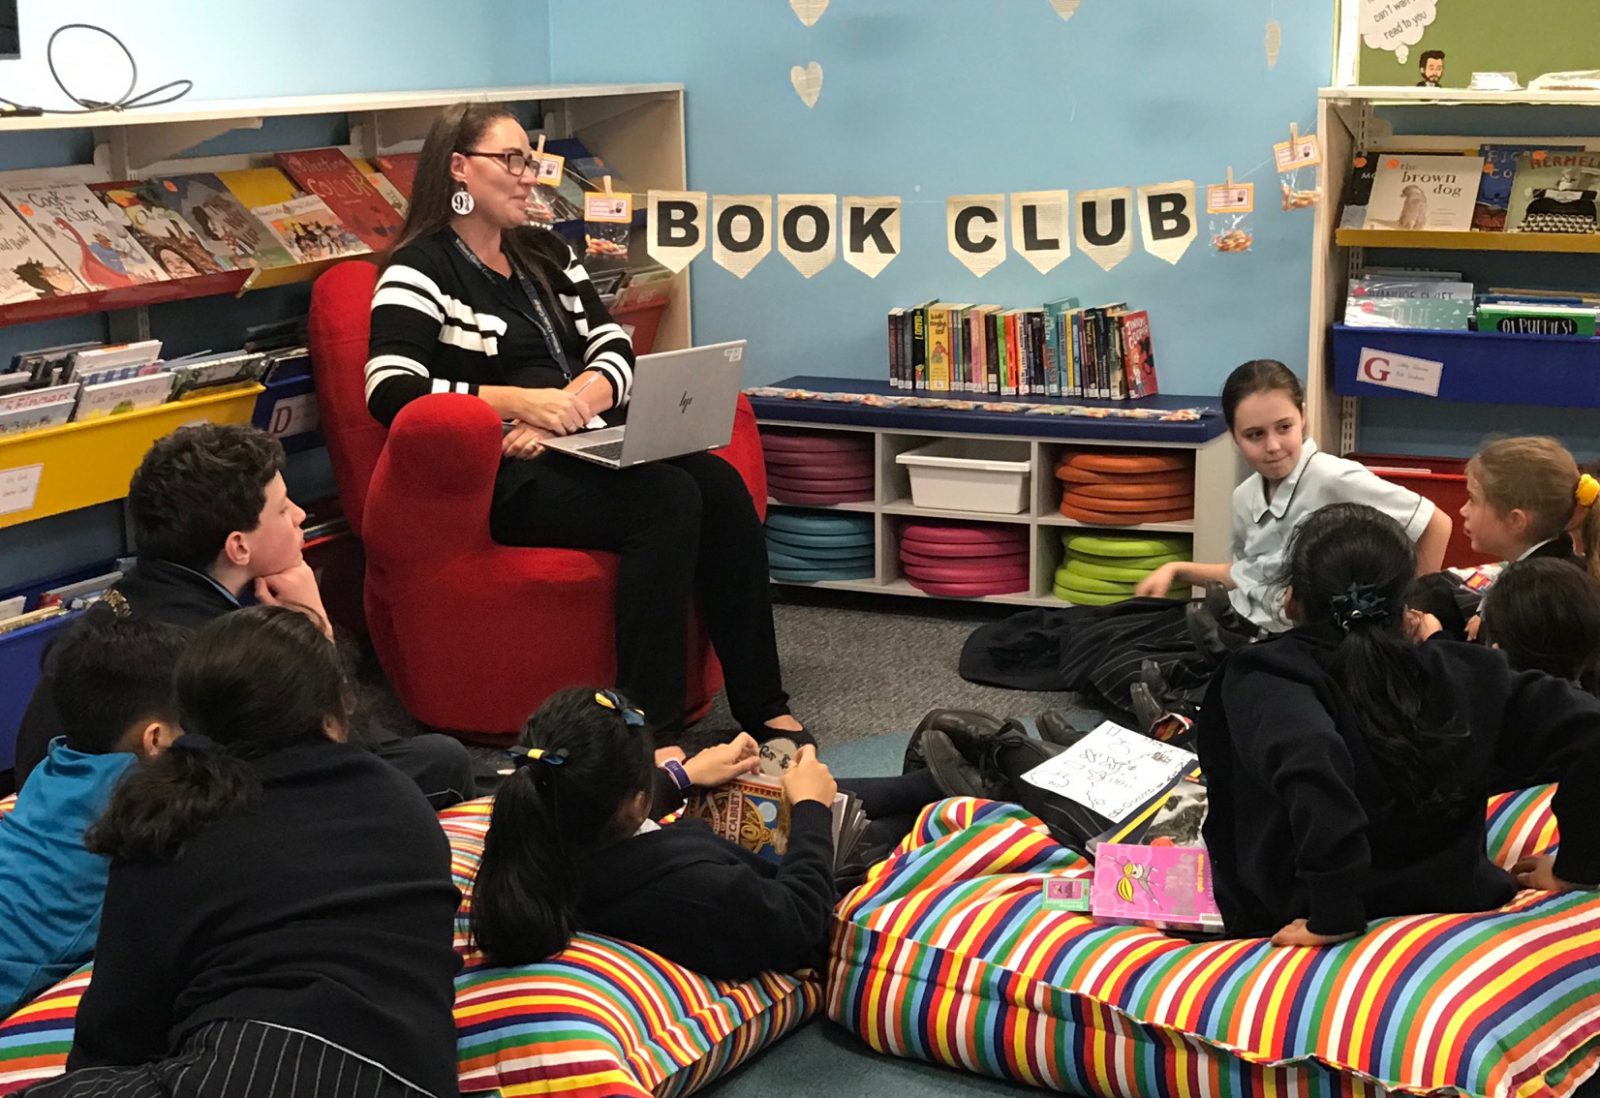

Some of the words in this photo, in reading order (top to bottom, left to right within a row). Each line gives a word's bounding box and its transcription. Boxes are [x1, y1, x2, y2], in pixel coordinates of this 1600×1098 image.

[1384, 22, 1404, 40] read
[1402, 19, 1412, 29] to
[1412, 11, 1427, 27] you
[306, 174, 375, 198] COLOUR
[1401, 171, 1457, 183] brown
[28, 190, 73, 208] Cook
[1433, 184, 1463, 198] dog
[57, 206, 106, 227] King
[657, 201, 897, 254] BOOK
[954, 193, 1191, 253] CLUB
[1363, 357, 1391, 382] G
[272, 405, 293, 434] D
[727, 792, 741, 833] CABRET
